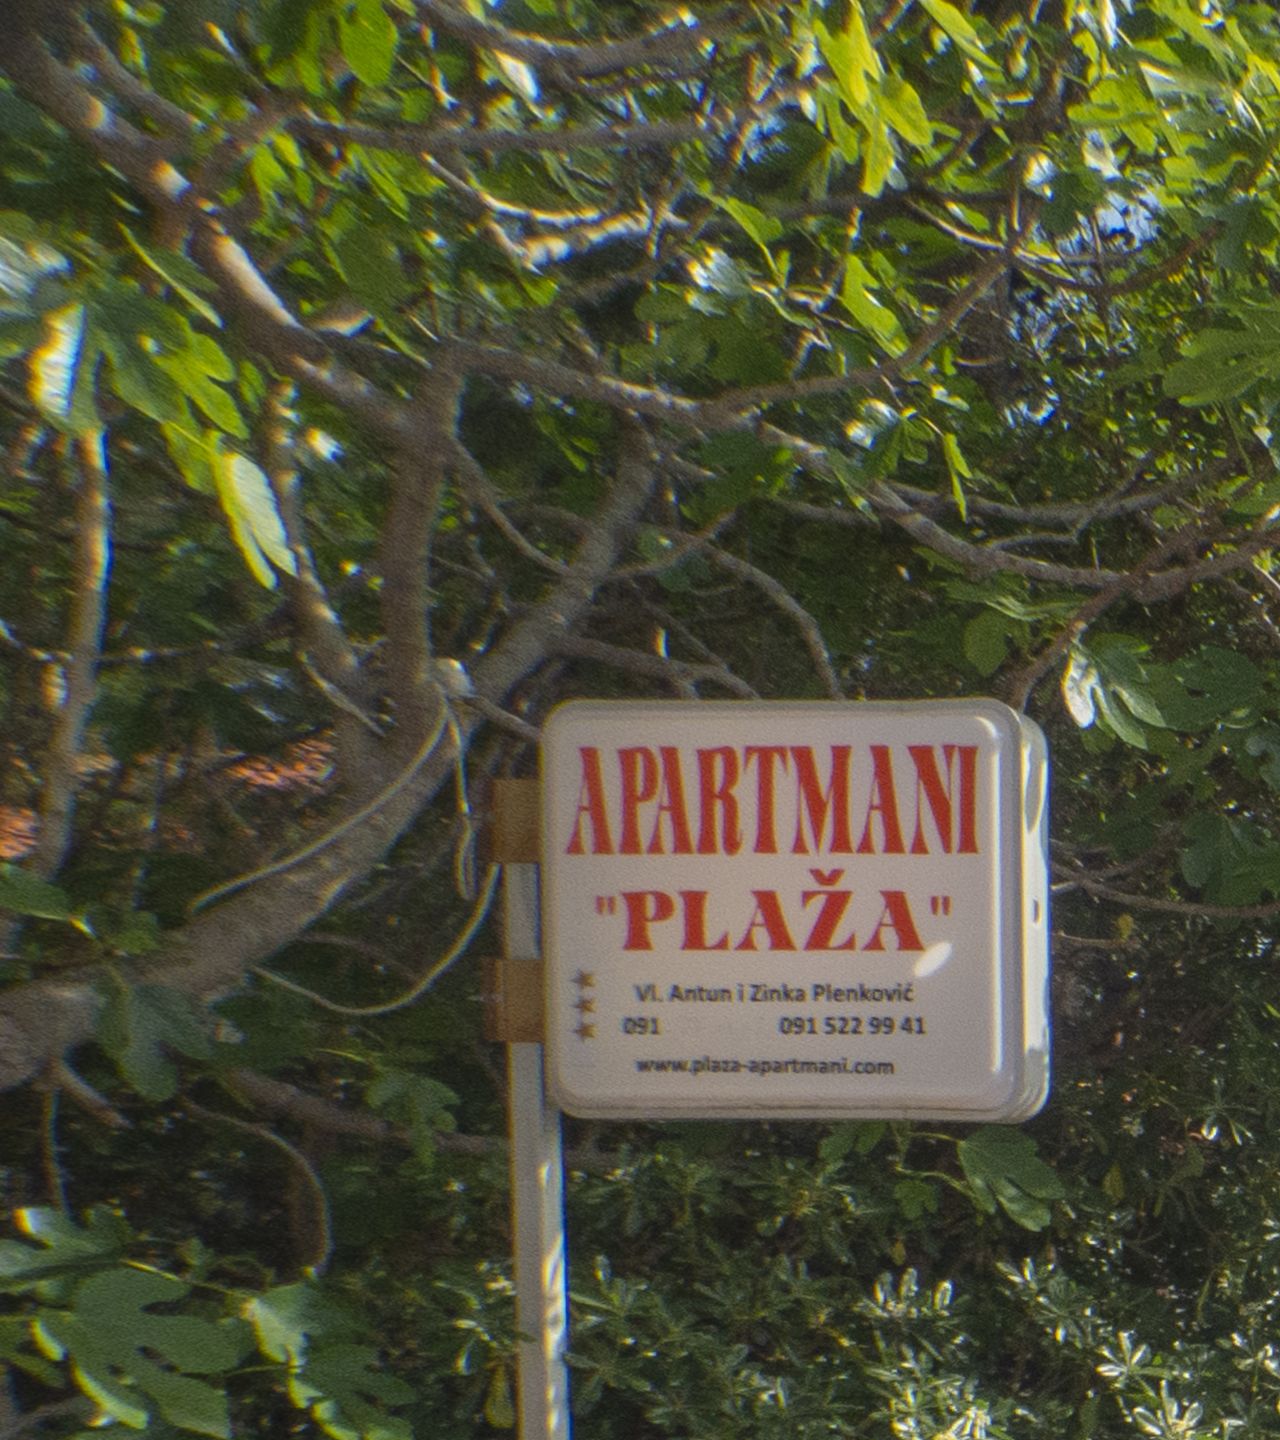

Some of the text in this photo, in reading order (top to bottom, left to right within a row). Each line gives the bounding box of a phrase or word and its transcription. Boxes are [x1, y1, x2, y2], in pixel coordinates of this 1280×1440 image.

[565, 744, 980, 857] APARTMANI
[595, 868, 952, 953] "PLAŽA"
[669, 983, 732, 1003] Antun
[737, 982, 745, 1003] i
[749, 982, 807, 1003] Zinka
[812, 982, 915, 1003] Plenković
[621, 1015, 927, 1036] 091 091 522 99 41
[634, 1055, 895, 1077] www.plaza-apartmani.com
